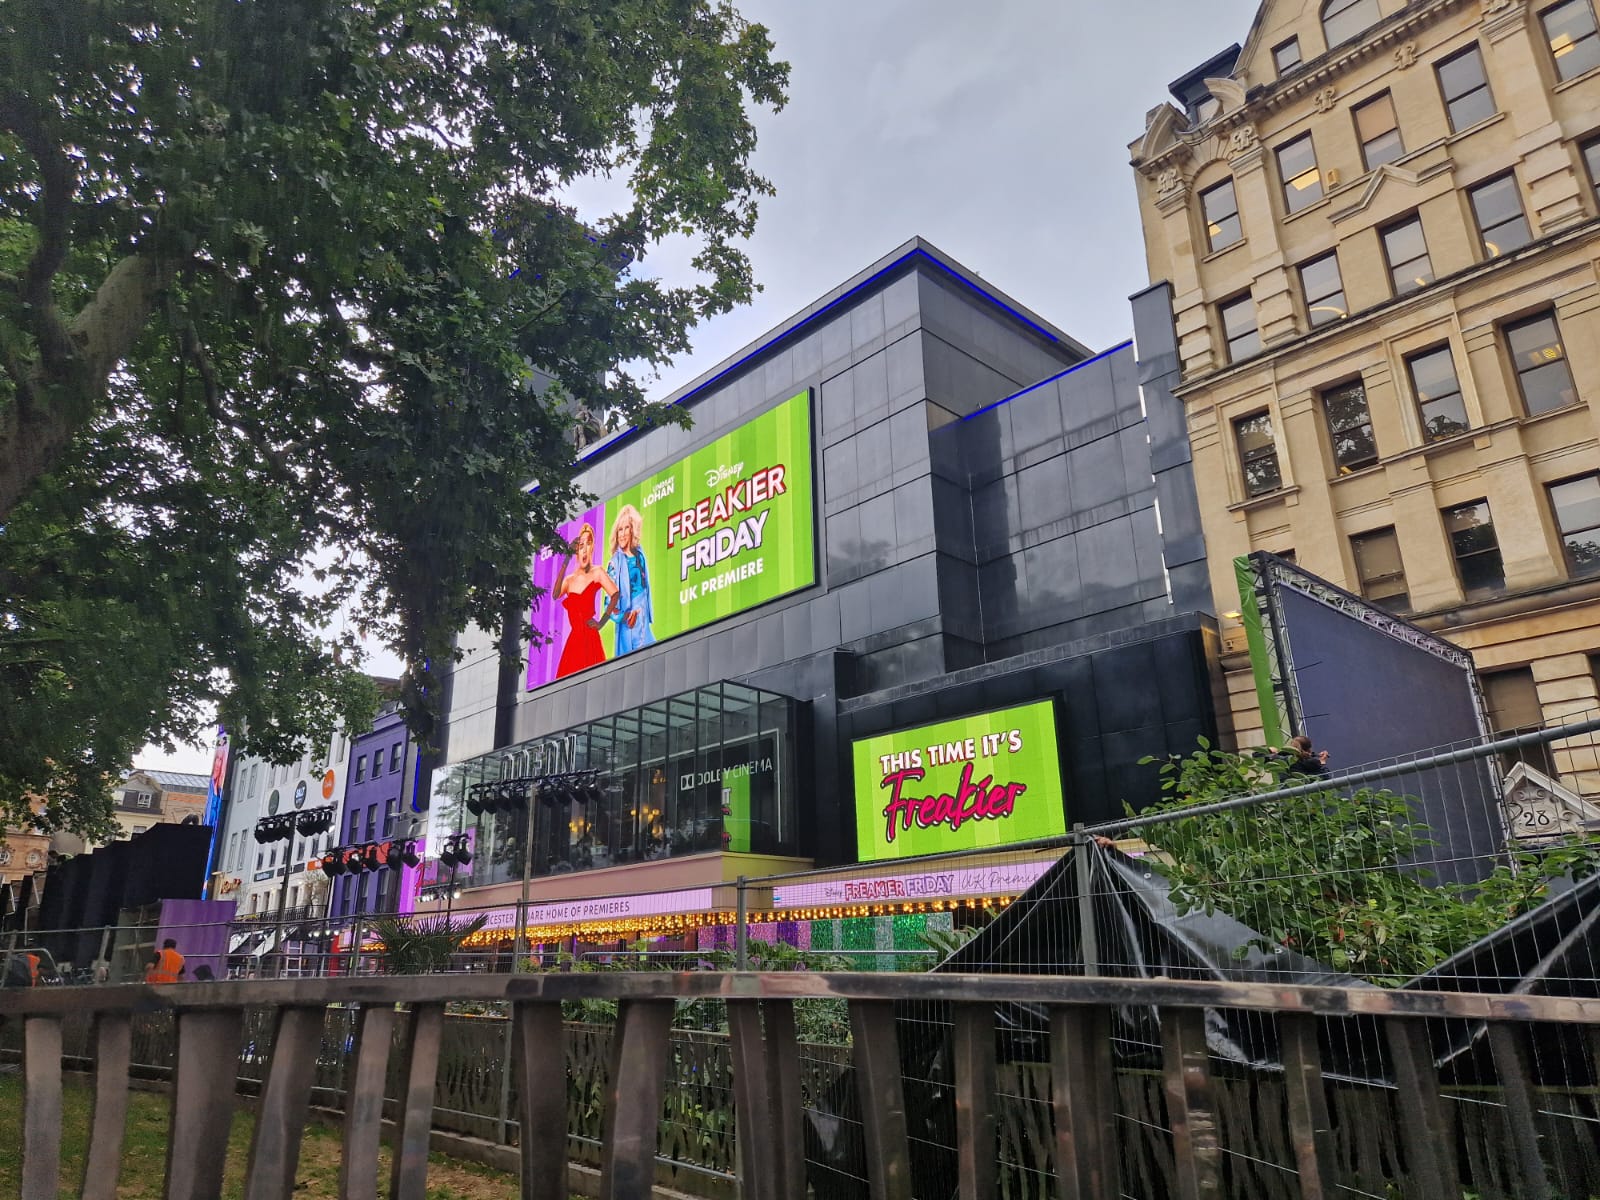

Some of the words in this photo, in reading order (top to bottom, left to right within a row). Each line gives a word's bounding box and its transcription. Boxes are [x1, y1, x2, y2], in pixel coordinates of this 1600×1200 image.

[643, 483, 675, 508] LOHAN
[667, 464, 786, 549] FREAKIER
[680, 508, 770, 582] FRIDAY
[679, 584, 698, 605] UK
[701, 558, 764, 596] PREMIERE
[733, 757, 772, 778] CINEMA
[880, 748, 922, 775] THIS
[926, 738, 976, 767] TIME
[981, 729, 1023, 757] IT'S
[880, 762, 1027, 843] Freakier
[844, 880, 905, 901] FREAKIER
[905, 875, 954, 897] FRIDAY
[962, 872, 987, 890] UK
[546, 907, 569, 920] HOME
[570, 905, 582, 917] OF
[583, 901, 631, 916] PREMIERES
